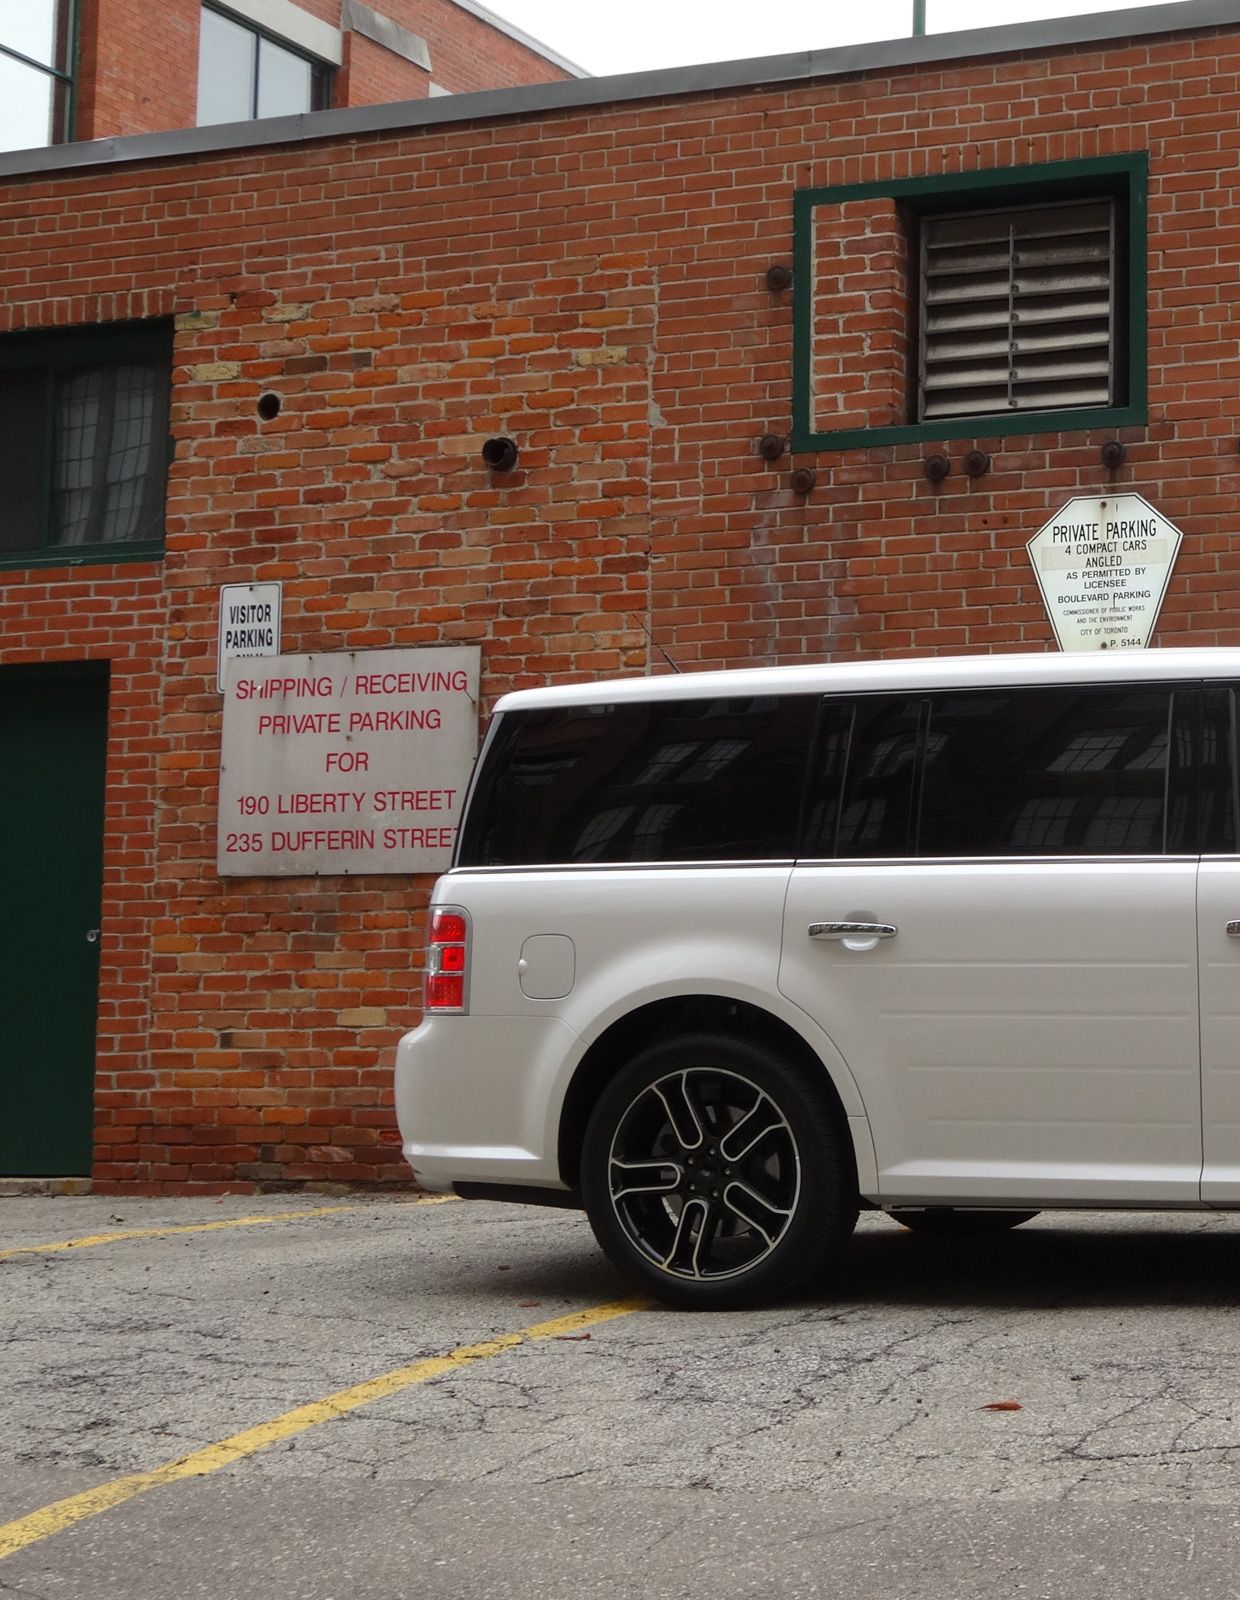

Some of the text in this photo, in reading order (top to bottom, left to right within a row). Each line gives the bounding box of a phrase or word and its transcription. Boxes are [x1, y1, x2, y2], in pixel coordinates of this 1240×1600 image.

[1052, 518, 1157, 543] PRIVATE PARKING
[1064, 539, 1147, 555] 4 COMPACT CARS
[1085, 555, 1122, 568] ANGLED
[1066, 567, 1146, 580] AS PERMITTED BY
[1084, 578, 1127, 589] LICENSEE
[1057, 590, 1151, 604] BOULEVARD PARKING
[229, 603, 271, 625] VISITOR
[1063, 608, 1099, 616] COMMISSIONER
[226, 628, 273, 649] PARKING
[1104, 626, 1129, 634] TORONTO
[1121, 638, 1141, 647] 5144
[235, 677, 332, 700] SHIPPING
[355, 670, 468, 695] RECEIVING
[258, 709, 442, 735] PRIVATE PARKING
[325, 752, 369, 772] FOR
[237, 789, 457, 815] 190 LIBERTY STREET
[226, 827, 458, 853] 235 DUFFERIN STREE
